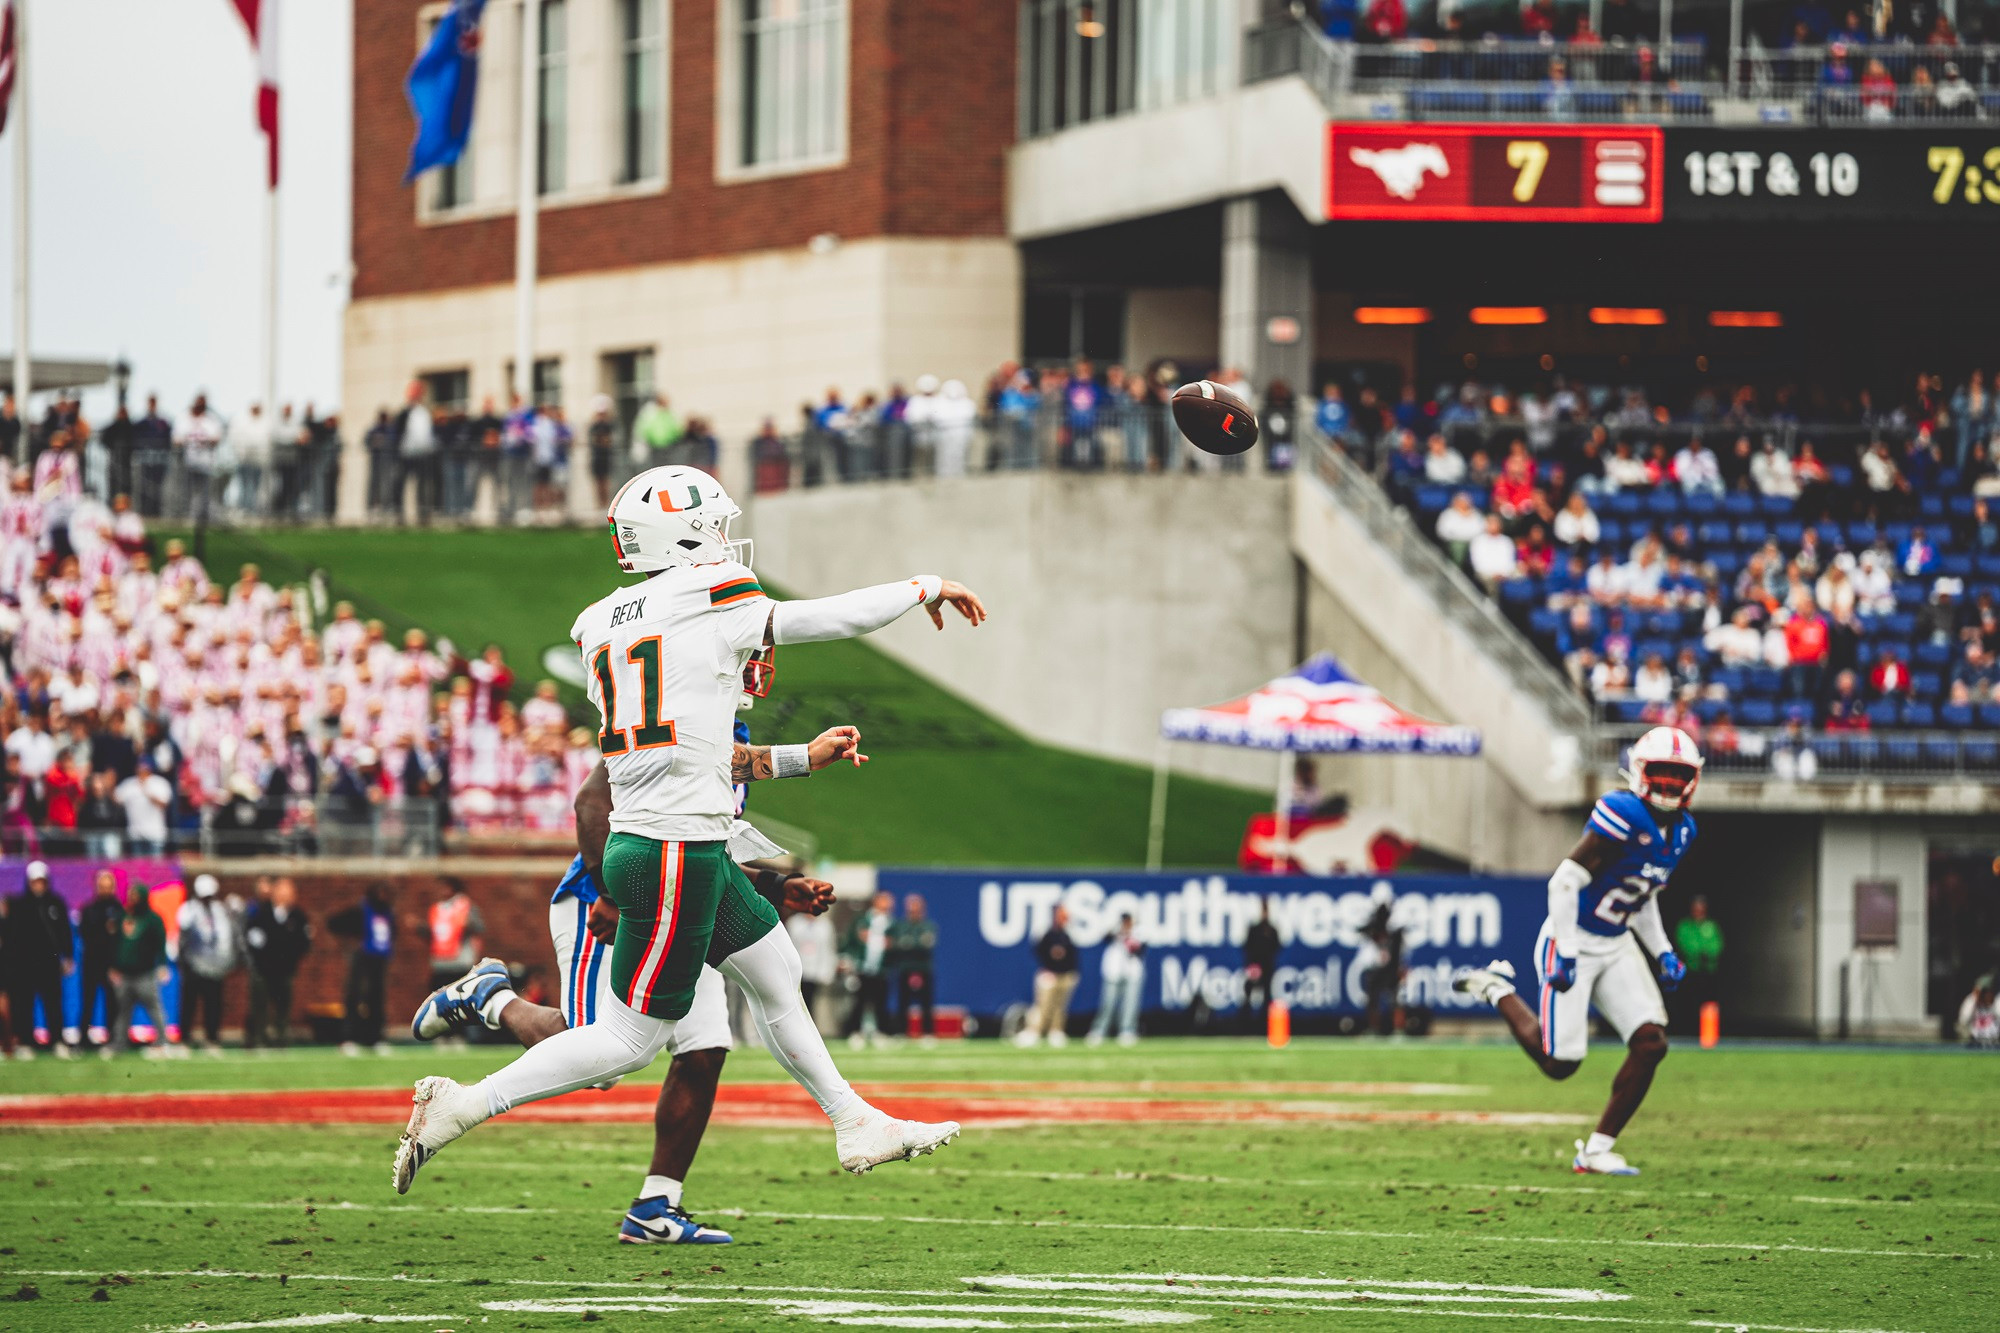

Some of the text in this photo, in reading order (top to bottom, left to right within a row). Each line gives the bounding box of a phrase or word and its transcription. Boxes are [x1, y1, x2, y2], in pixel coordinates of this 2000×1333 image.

[1506, 140, 1549, 202] 7
[1684, 151, 1859, 197] 1ST & 10
[657, 485, 703, 513] U
[609, 596, 647, 628] BECK
[592, 634, 677, 757] 11
